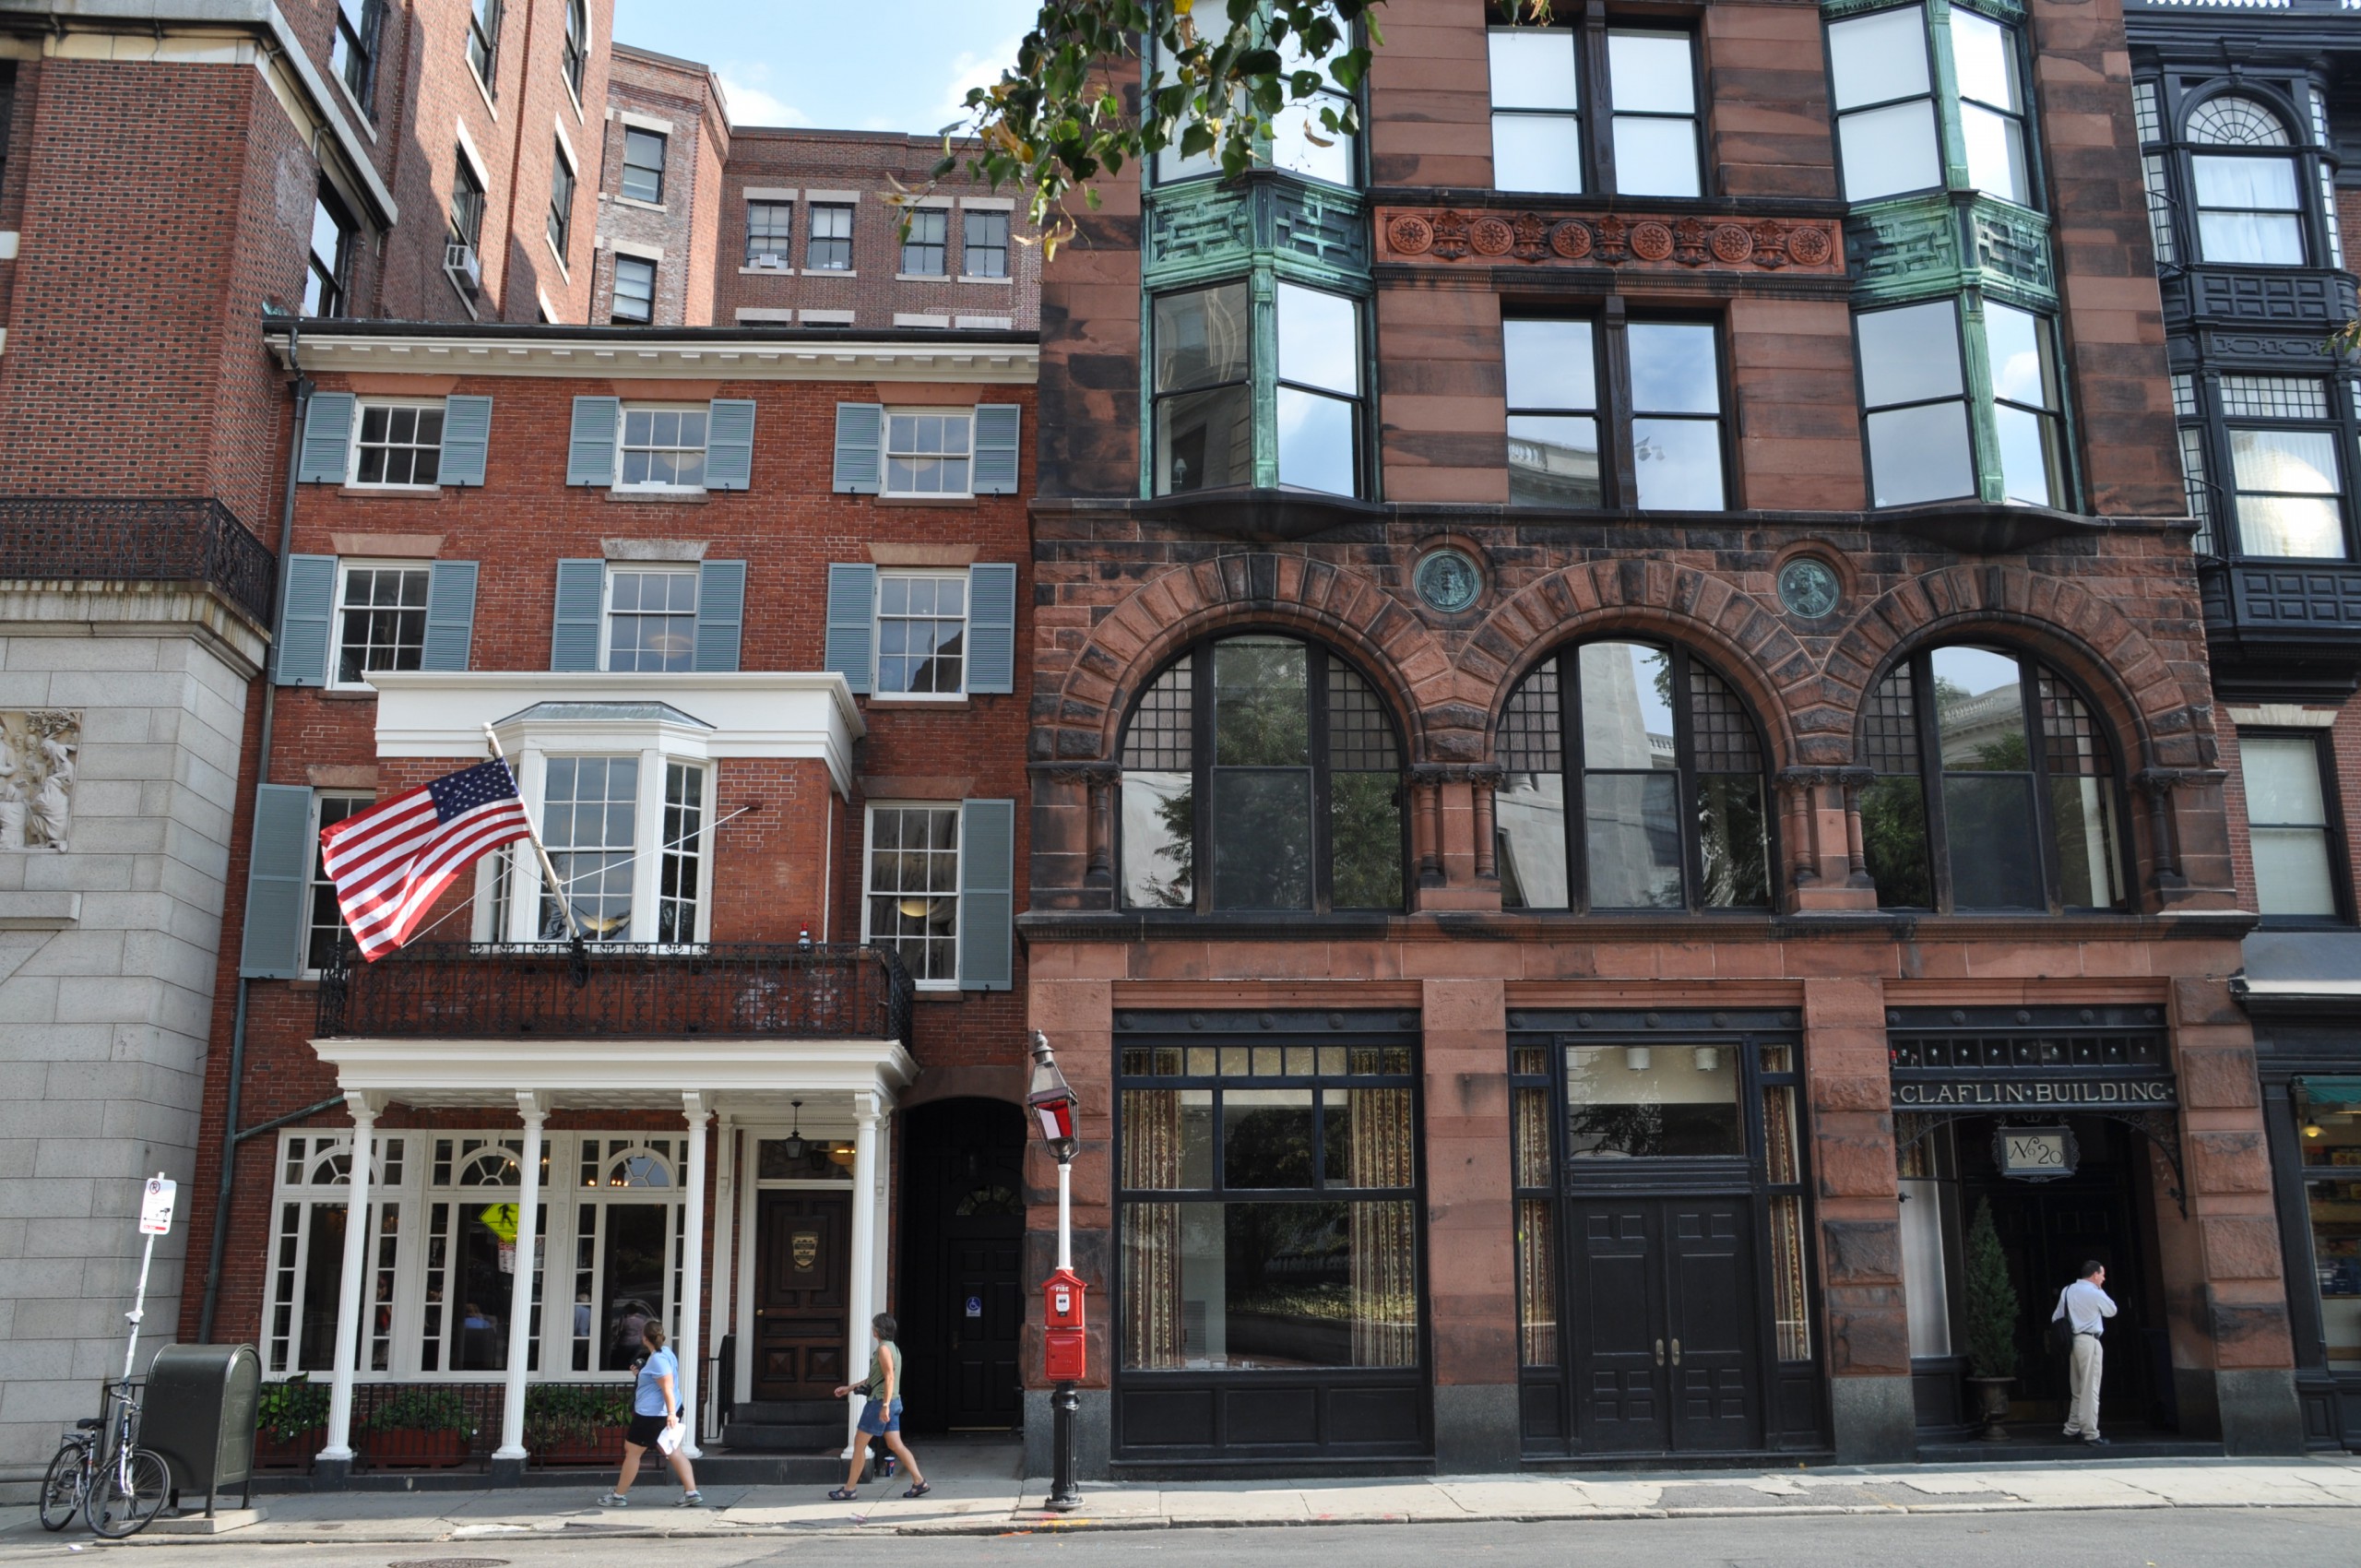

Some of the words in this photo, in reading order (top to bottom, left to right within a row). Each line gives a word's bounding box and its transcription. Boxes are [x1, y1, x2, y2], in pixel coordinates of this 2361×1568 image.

[1900, 1084, 2024, 1103] CLAFLIN
[2035, 1082, 2167, 1102] BUILDING
[2037, 1144, 2063, 1165] 20
